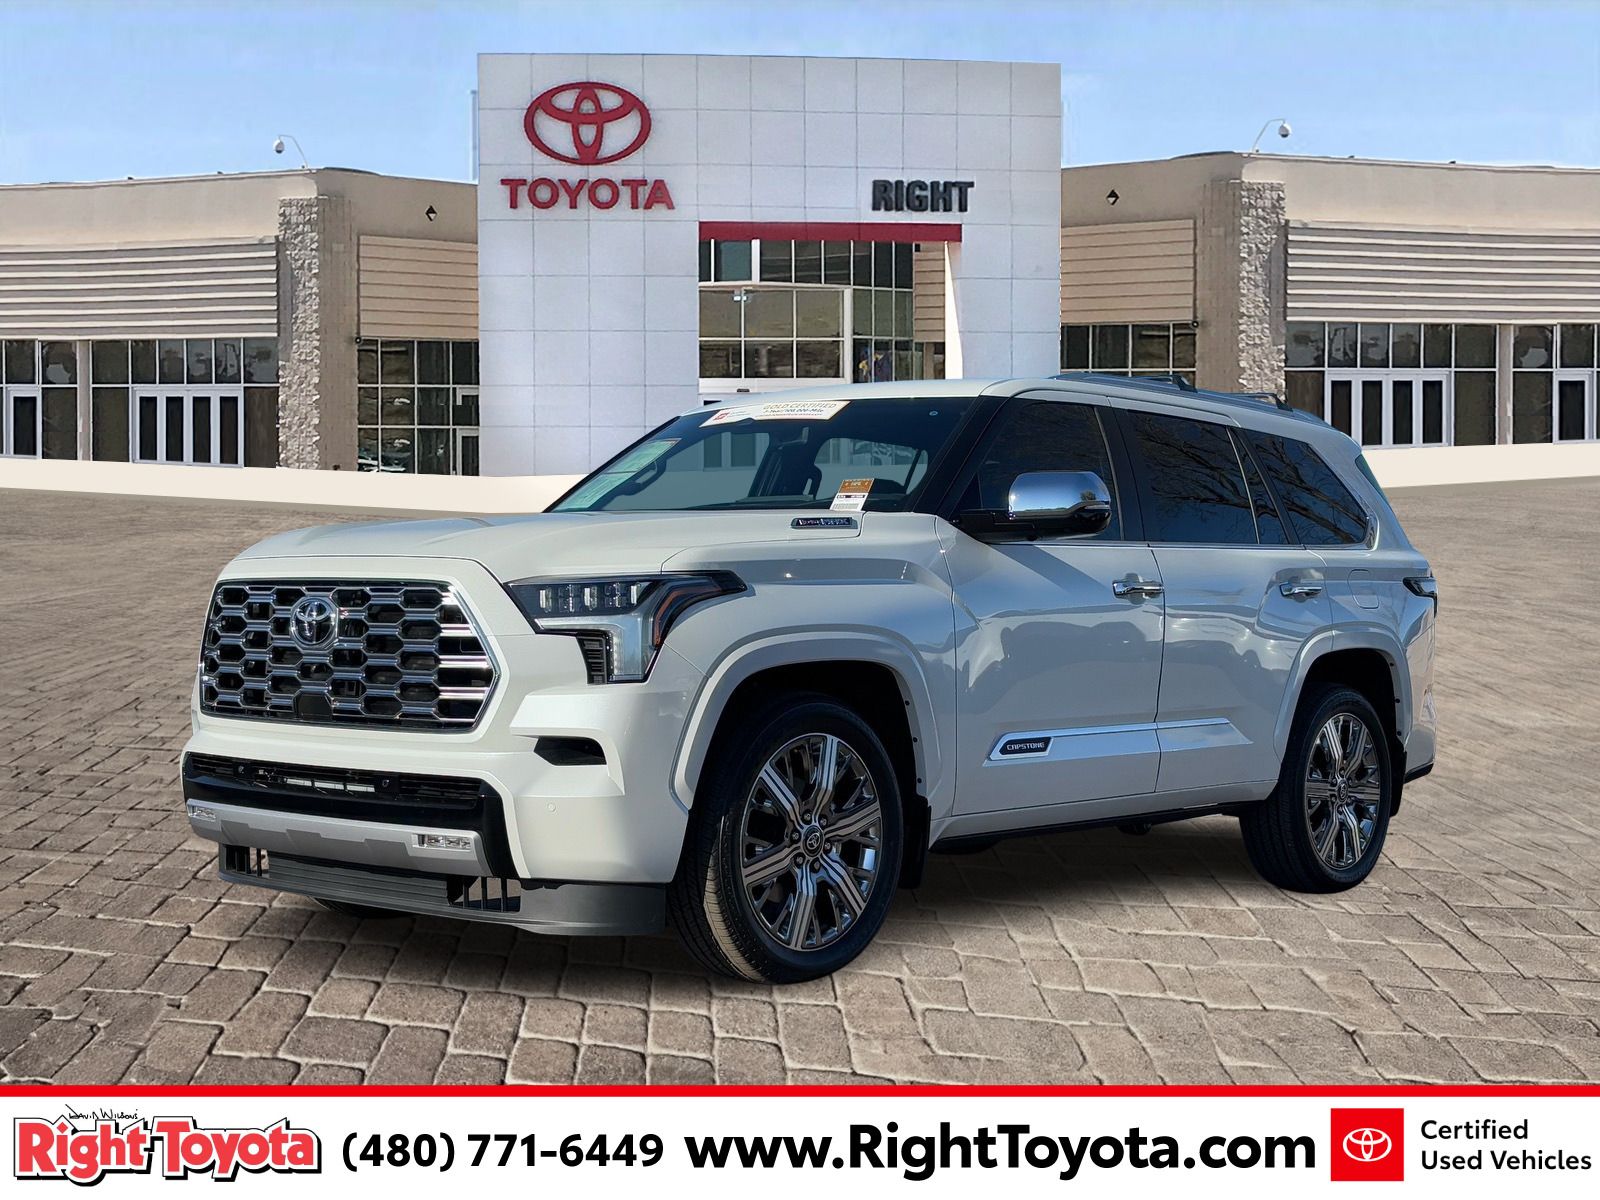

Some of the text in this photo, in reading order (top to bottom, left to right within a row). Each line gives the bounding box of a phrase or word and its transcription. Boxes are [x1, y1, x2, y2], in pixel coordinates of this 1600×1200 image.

[501, 179, 674, 210] TOYOTA
[872, 180, 975, 213] RIGHT
[1006, 742, 1045, 751] CAPSTONE
